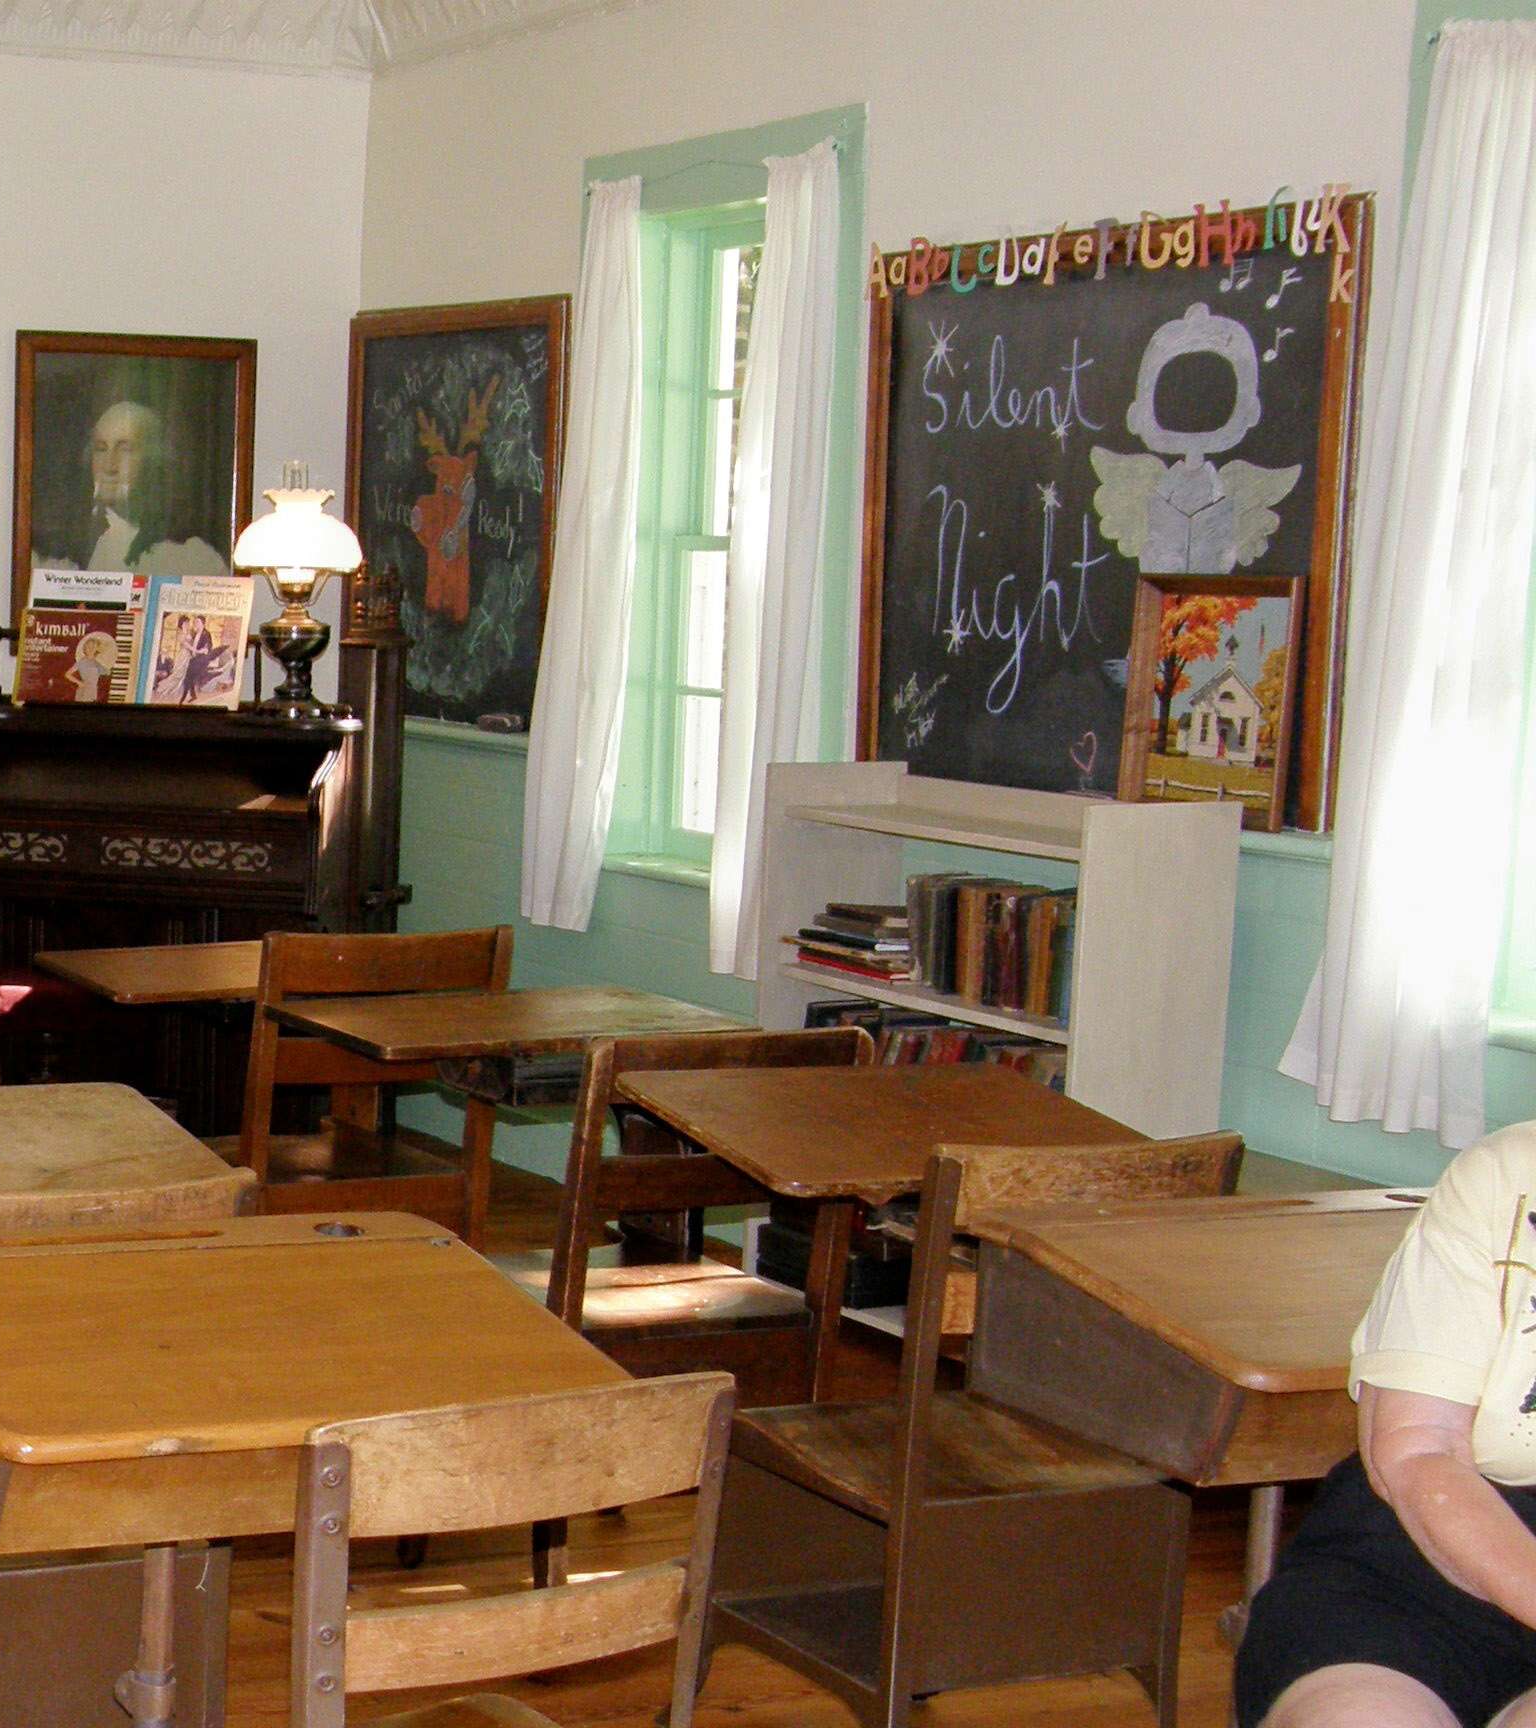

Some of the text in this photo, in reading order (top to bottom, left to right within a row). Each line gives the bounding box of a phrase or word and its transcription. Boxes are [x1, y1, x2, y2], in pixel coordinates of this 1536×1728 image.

[921, 334, 1104, 434] Silent
[44, 572, 124, 587] Winter Wonderland
[928, 484, 1111, 714] Night
